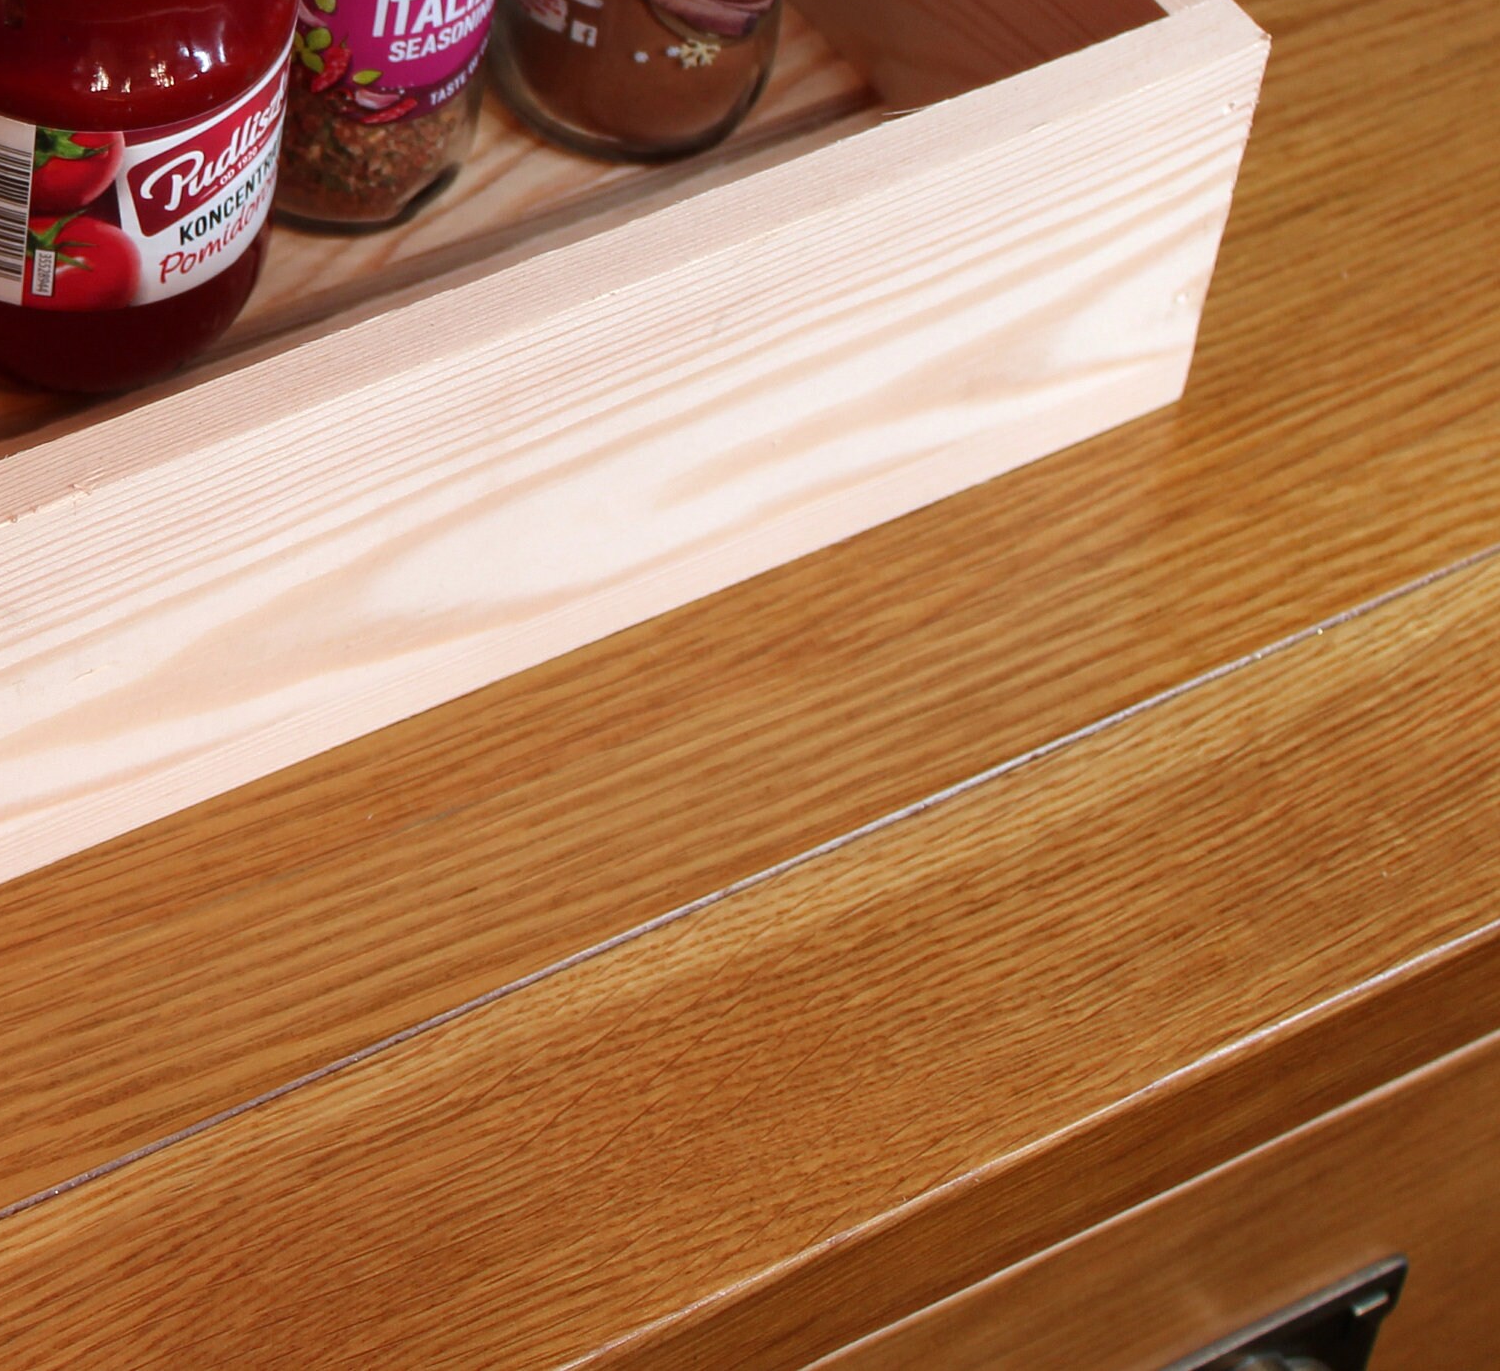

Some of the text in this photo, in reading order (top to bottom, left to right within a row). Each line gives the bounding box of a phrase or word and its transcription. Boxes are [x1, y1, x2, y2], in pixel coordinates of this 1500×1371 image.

[430, 70, 467, 106] TASTE
[220, 149, 259, 185] OD 1920
